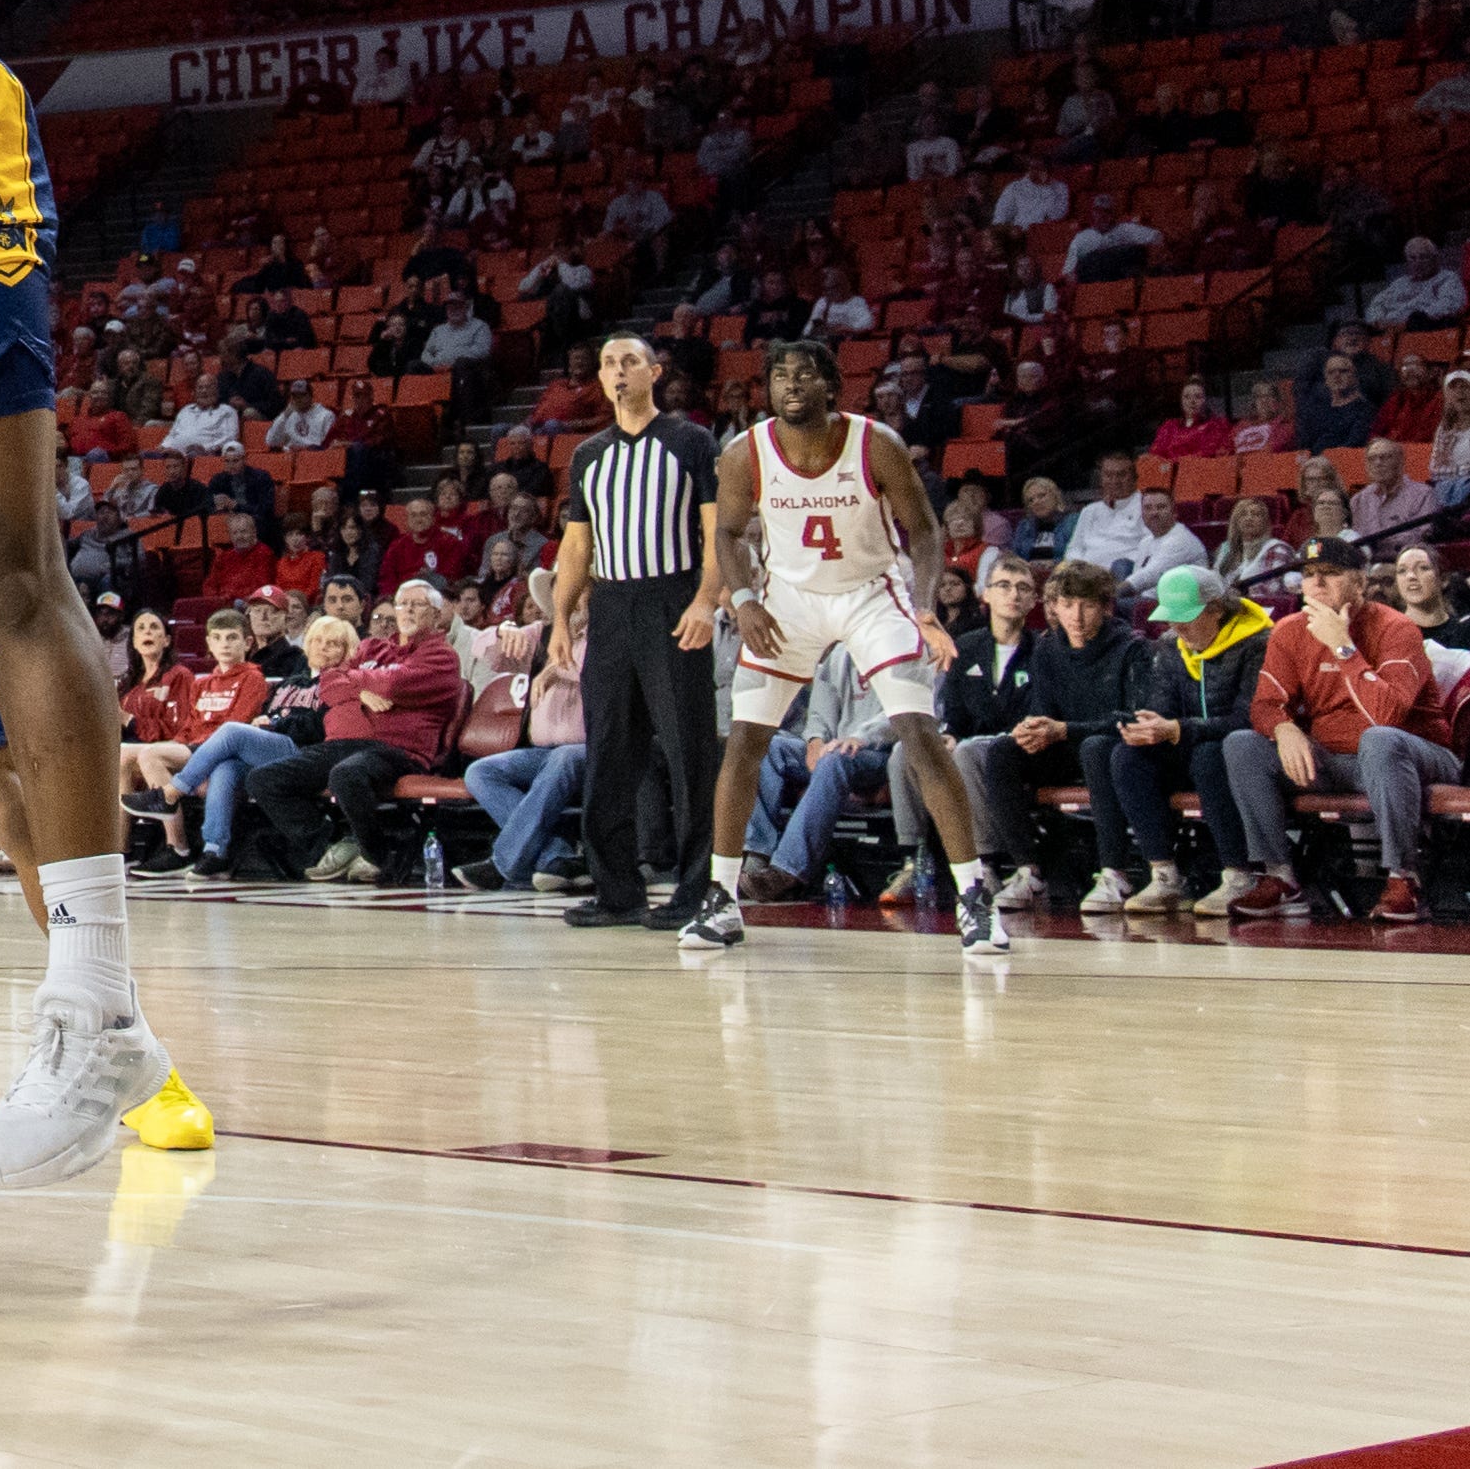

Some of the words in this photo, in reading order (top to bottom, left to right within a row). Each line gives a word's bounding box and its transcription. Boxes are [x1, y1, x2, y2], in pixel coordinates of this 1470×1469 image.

[563, 8, 599, 62] A
[770, 494, 861, 509] OKLAHOMA
[802, 516, 844, 561] 4
